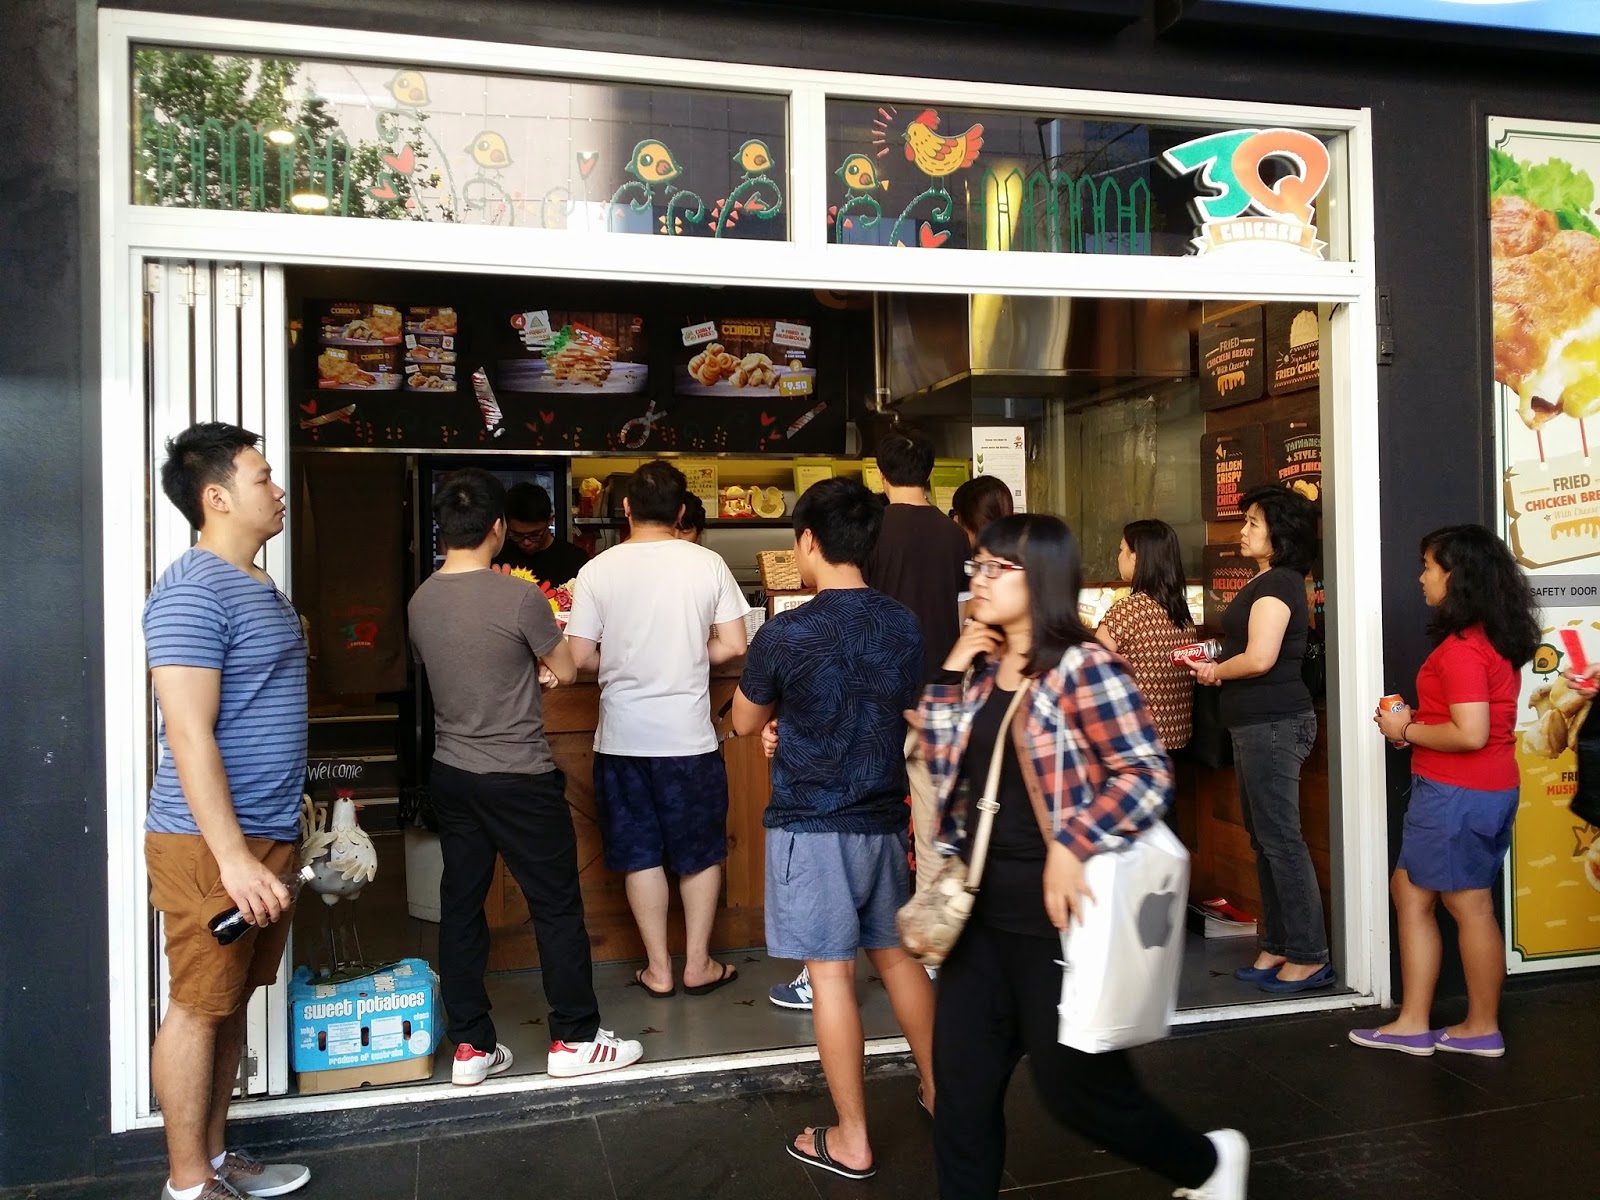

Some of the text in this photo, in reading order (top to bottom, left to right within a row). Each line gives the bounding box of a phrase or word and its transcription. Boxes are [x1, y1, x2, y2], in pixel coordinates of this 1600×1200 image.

[1164, 129, 1331, 225] 3Q
[1220, 221, 1303, 244] CHICKEN
[330, 307, 355, 315] COMBO
[515, 317, 522, 326] 4
[721, 324, 771, 337] COMBO E
[775, 332, 807, 342] MUSHROOM
[1219, 336, 1240, 352] FRIED
[1206, 347, 1255, 370] CHICKEN BREAST
[1216, 360, 1245, 375] With Cheese
[1275, 367, 1296, 381] FRIED
[783, 380, 808, 391] $9.50
[1293, 449, 1317, 461] STYLE
[1216, 459, 1243, 473] GOLDEN
[1278, 463, 1300, 479] FRIED
[1216, 470, 1242, 484] CRISPY
[1552, 473, 1591, 492] FRIED
[1216, 482, 1238, 495] FRIED
[1524, 493, 1577, 513] CHICKEN
[1530, 585, 1598, 597] SAFETY DOOR
[306, 761, 363, 781] Welcome
[303, 991, 425, 1021] sweet potatoes
[419, 1021, 424, 1029] 1
[360, 1052, 370, 1062] of
